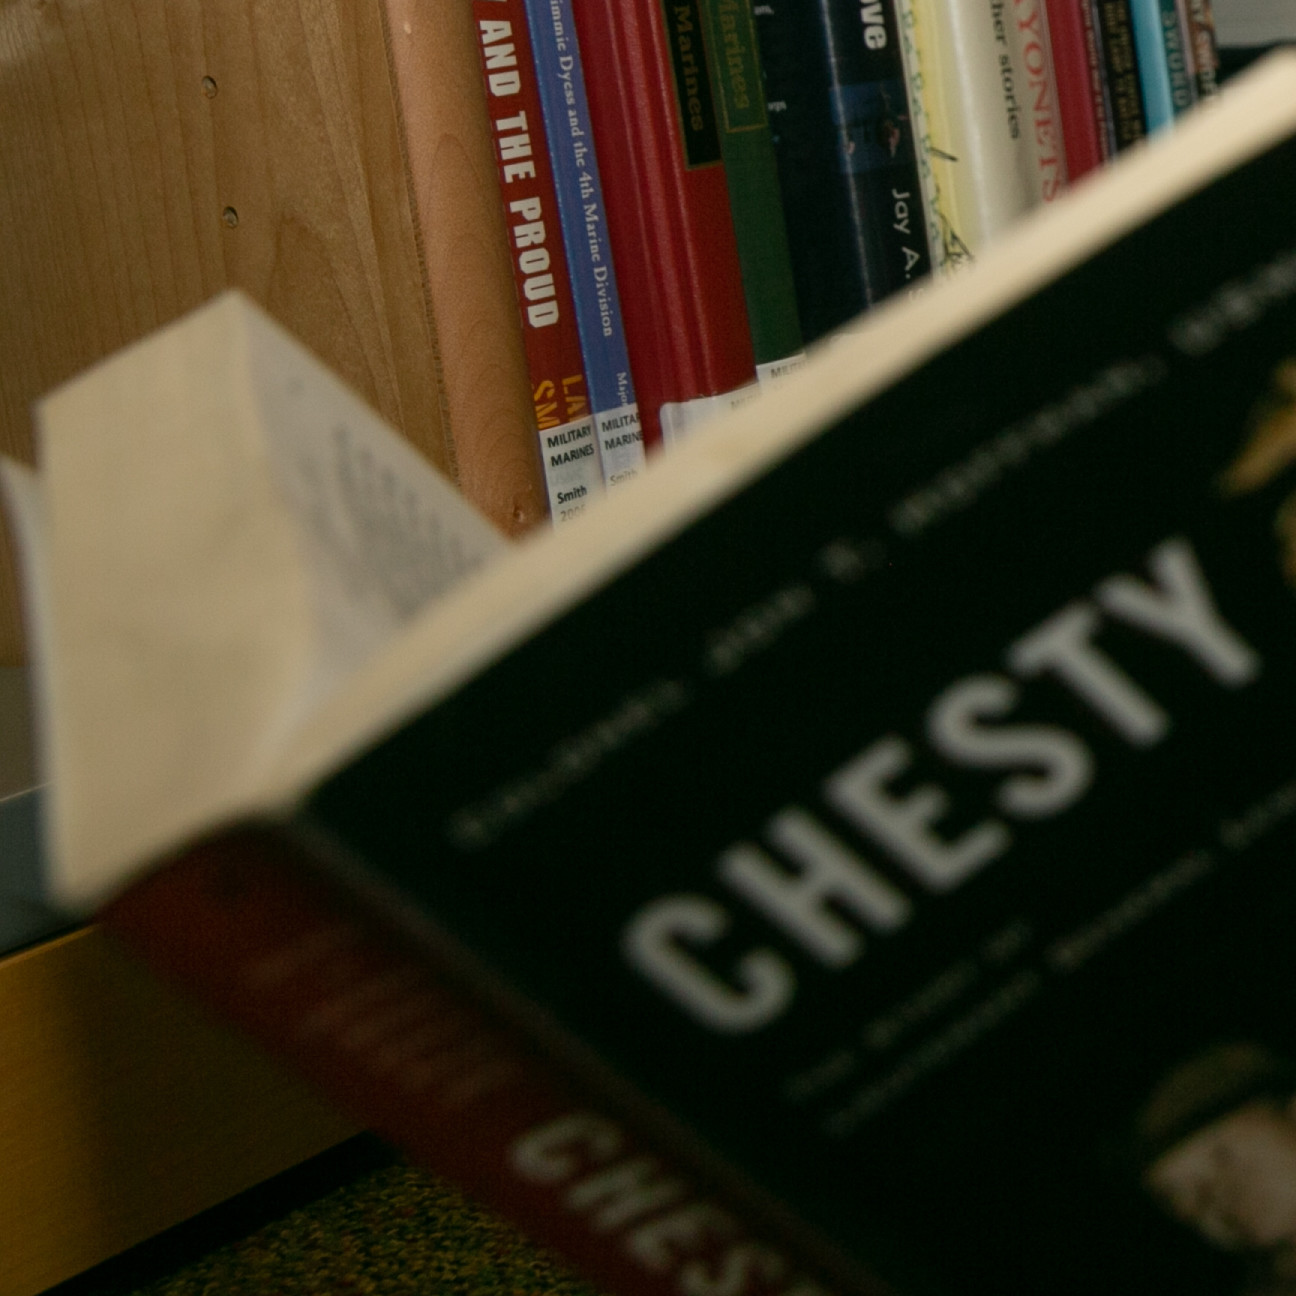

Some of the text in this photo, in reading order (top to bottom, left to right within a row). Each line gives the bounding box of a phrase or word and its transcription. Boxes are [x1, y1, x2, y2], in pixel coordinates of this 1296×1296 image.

[479, 20, 522, 97] AND
[556, 55, 577, 107] Dyess
[674, 5, 703, 132] Marines
[567, 108, 584, 137] and
[998, 53, 1021, 140] stories
[495, 110, 537, 184] THE
[573, 140, 589, 167] the
[579, 171, 594, 199] 4th
[893, 188, 911, 235] Jay
[583, 203, 602, 262] Marine
[509, 196, 560, 329] PROUD
[901, 246, 921, 282] A.
[594, 267, 613, 337] Division
[547, 425, 592, 448] MILITARY
[551, 443, 595, 467] MARINES
[557, 485, 588, 505] Smith
[622, 537, 1262, 1034] CHESTY
[508, 1109, 832, 1296] CHES
